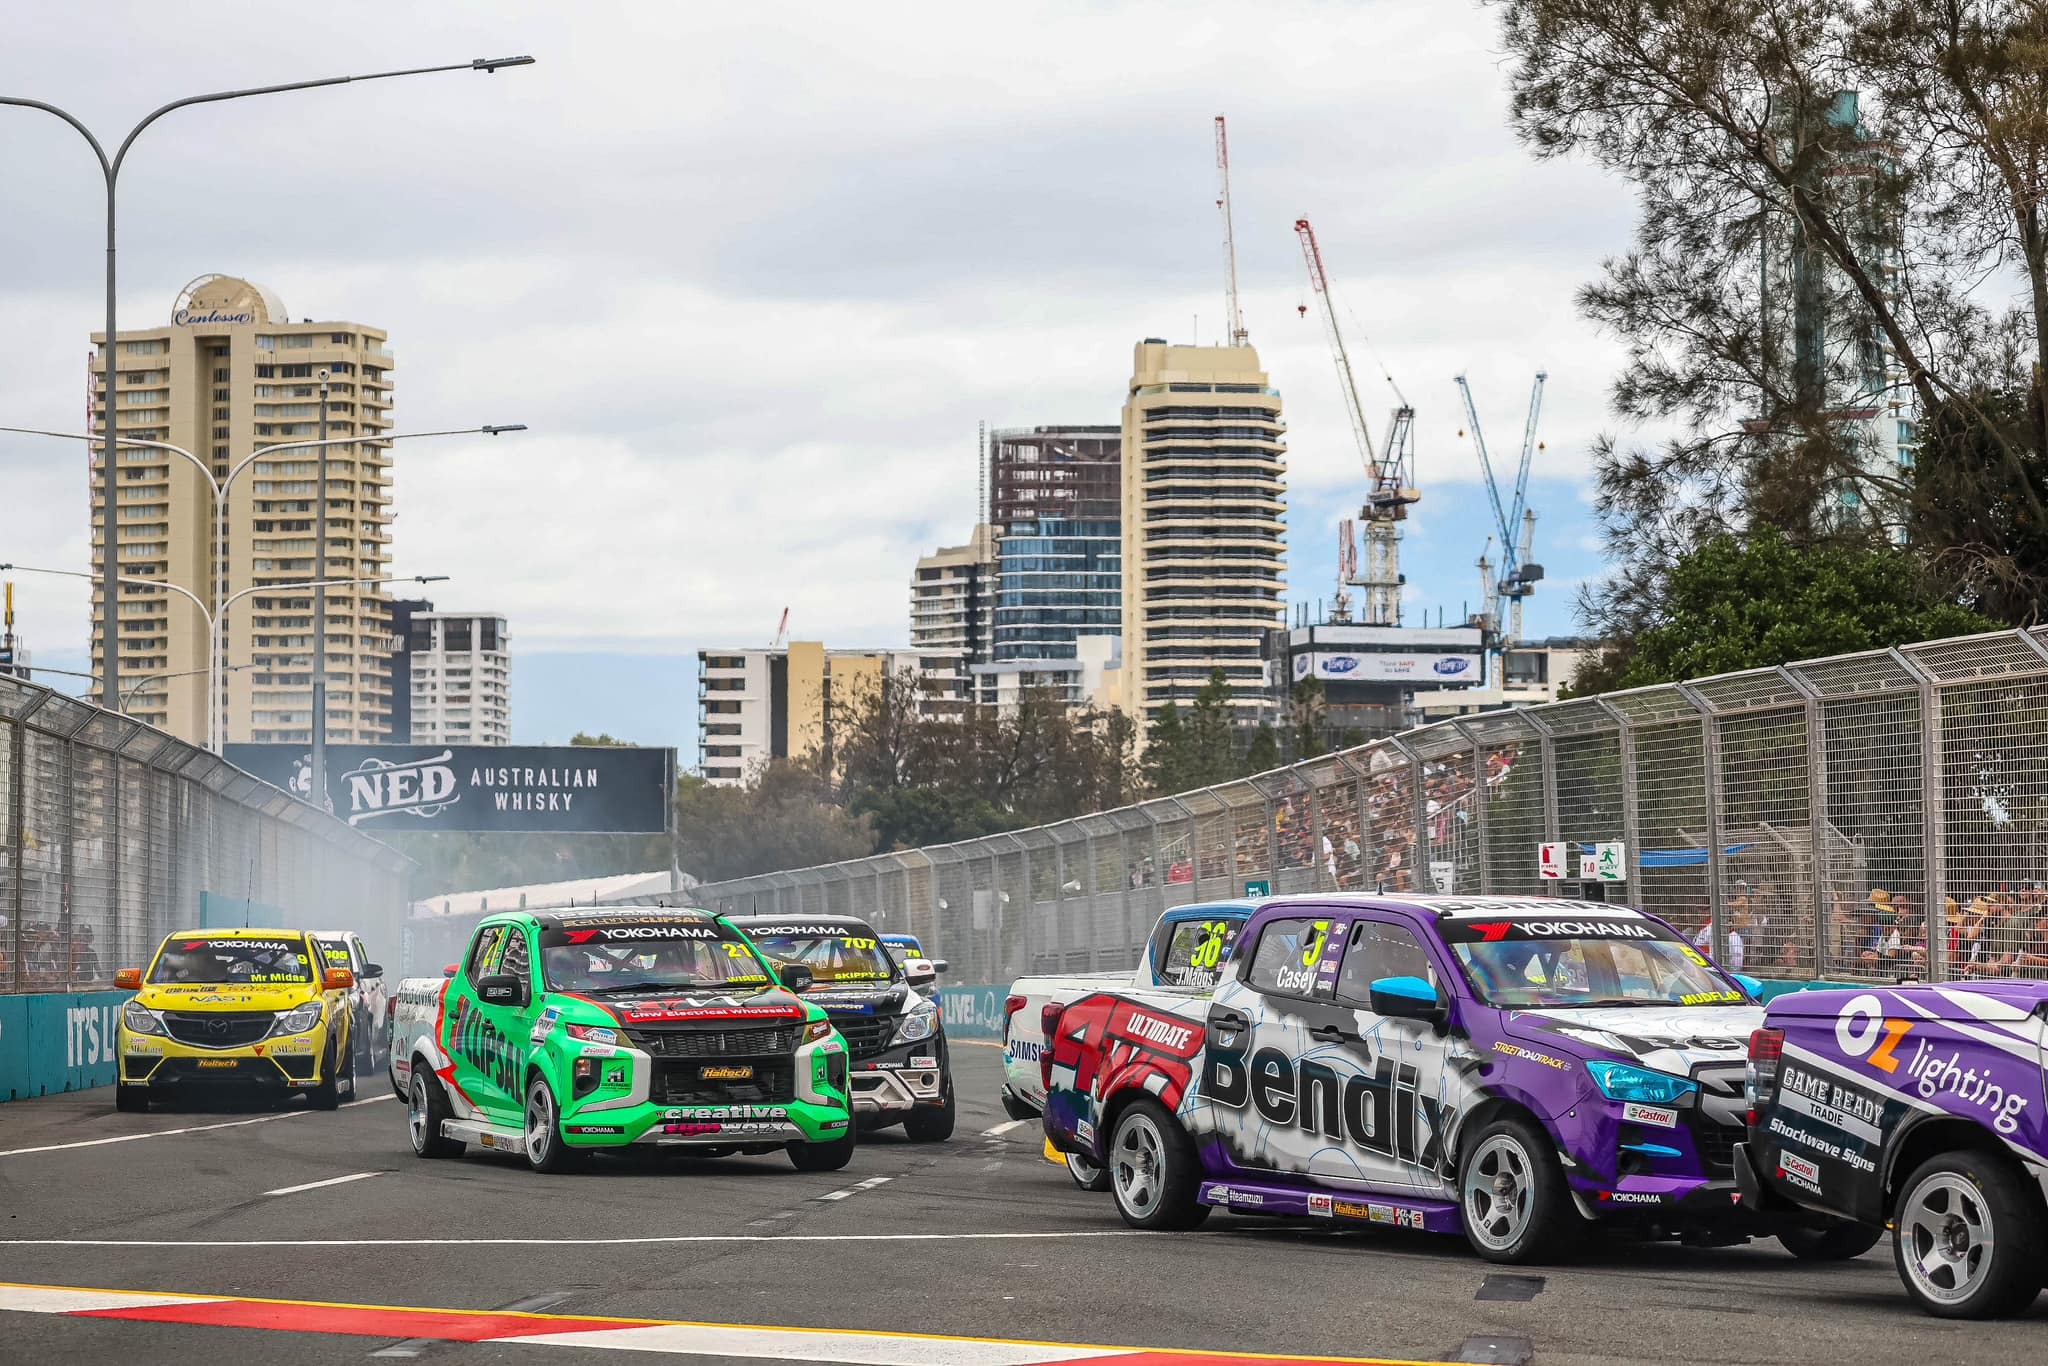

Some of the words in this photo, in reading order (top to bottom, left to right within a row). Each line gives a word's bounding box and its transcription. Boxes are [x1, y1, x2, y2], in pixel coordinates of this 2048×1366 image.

[349, 766, 457, 811] NED
[470, 768, 598, 787] AUSTRALIAN
[495, 792, 573, 812] WHISKY
[600, 927, 718, 939] YOKOHAMA
[747, 926, 849, 936] YOKOHAMA
[1513, 922, 1656, 938] YOKOHAMA
[207, 941, 289, 951] YOKOHAMA
[721, 944, 753, 959] 21
[840, 937, 877, 950] 707
[297, 954, 308, 965] 9
[1680, 946, 1708, 967] 5
[250, 974, 267, 982] Mr
[270, 973, 306, 982] Midas
[725, 975, 767, 983] WIRED
[834, 972, 877, 980] SKIPPY
[1276, 965, 1317, 995] Casey
[1680, 991, 1742, 1005] MUDFLAP
[666, 1009, 728, 1017] Electrical
[67, 1006, 99, 1067] IT'S
[1126, 1012, 1193, 1050] ULTIMATE
[465, 1007, 525, 1108] CLIPSAL
[703, 1067, 752, 1079] Haltech
[1201, 1003, 1456, 1180] Bendix
[1908, 1038, 2027, 1134] lighting
[1782, 1067, 1829, 1103] GAME
[1832, 1085, 1884, 1127] READY
[664, 1105, 787, 1119] creative
[1638, 1109, 1669, 1123] Castrol
[1809, 1104, 1844, 1126] TRADIE
[1769, 1117, 1841, 1158] Shockwave
[1841, 1148, 1876, 1173] Signs
[1790, 1159, 1814, 1177] Castrol
[1785, 1172, 1823, 1196] YOKOHAMA
[1611, 1192, 1661, 1204] YOKOHAMA
[1333, 1202, 1368, 1218] Haltech
